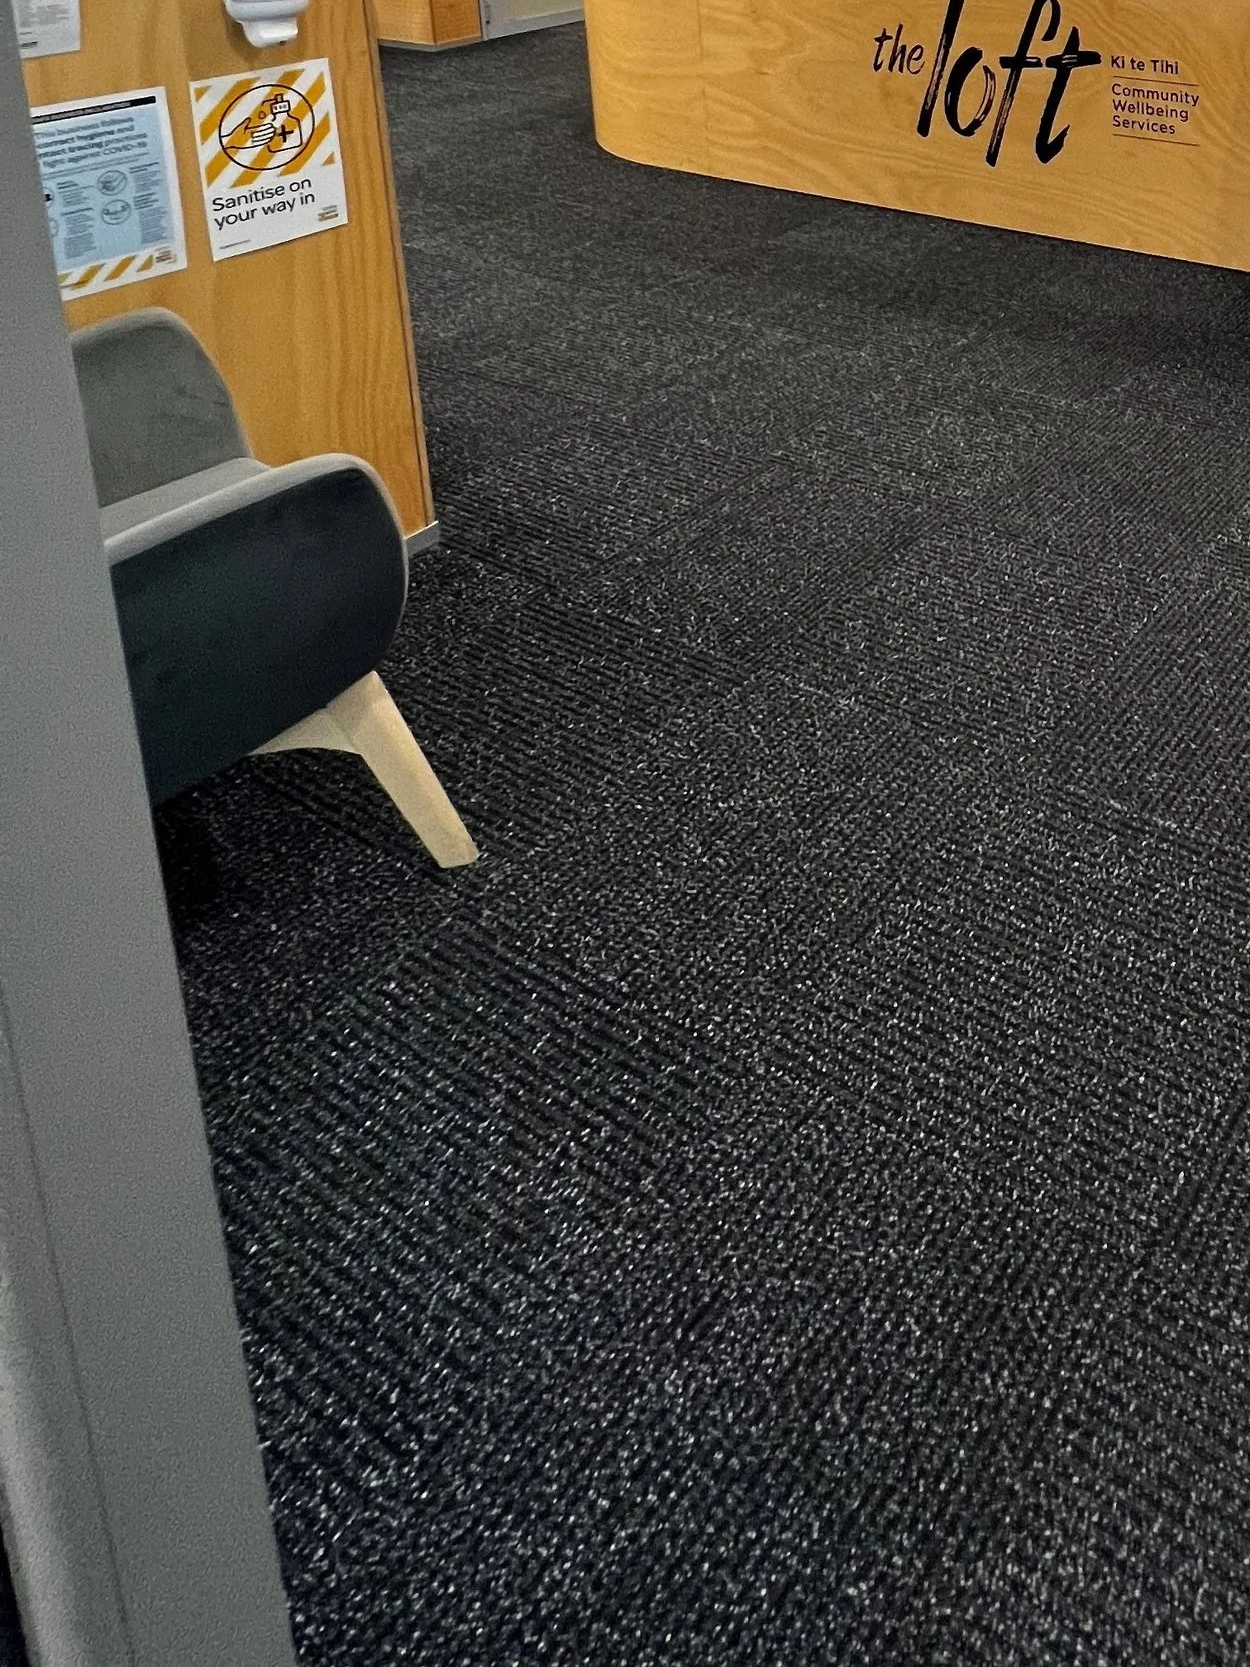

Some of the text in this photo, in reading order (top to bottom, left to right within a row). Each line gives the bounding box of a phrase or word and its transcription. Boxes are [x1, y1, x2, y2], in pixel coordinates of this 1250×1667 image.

[873, 23, 925, 75] the
[1111, 55, 1179, 75] Ki te Tihi
[1111, 83, 1200, 106] Community
[1112, 99, 1189, 122] Wellbeing
[1112, 115, 1176, 134] Services
[212, 178, 312, 212] Sanitise on
[214, 207, 258, 231] your
[261, 197, 297, 216] way
[299, 192, 316, 205] in
